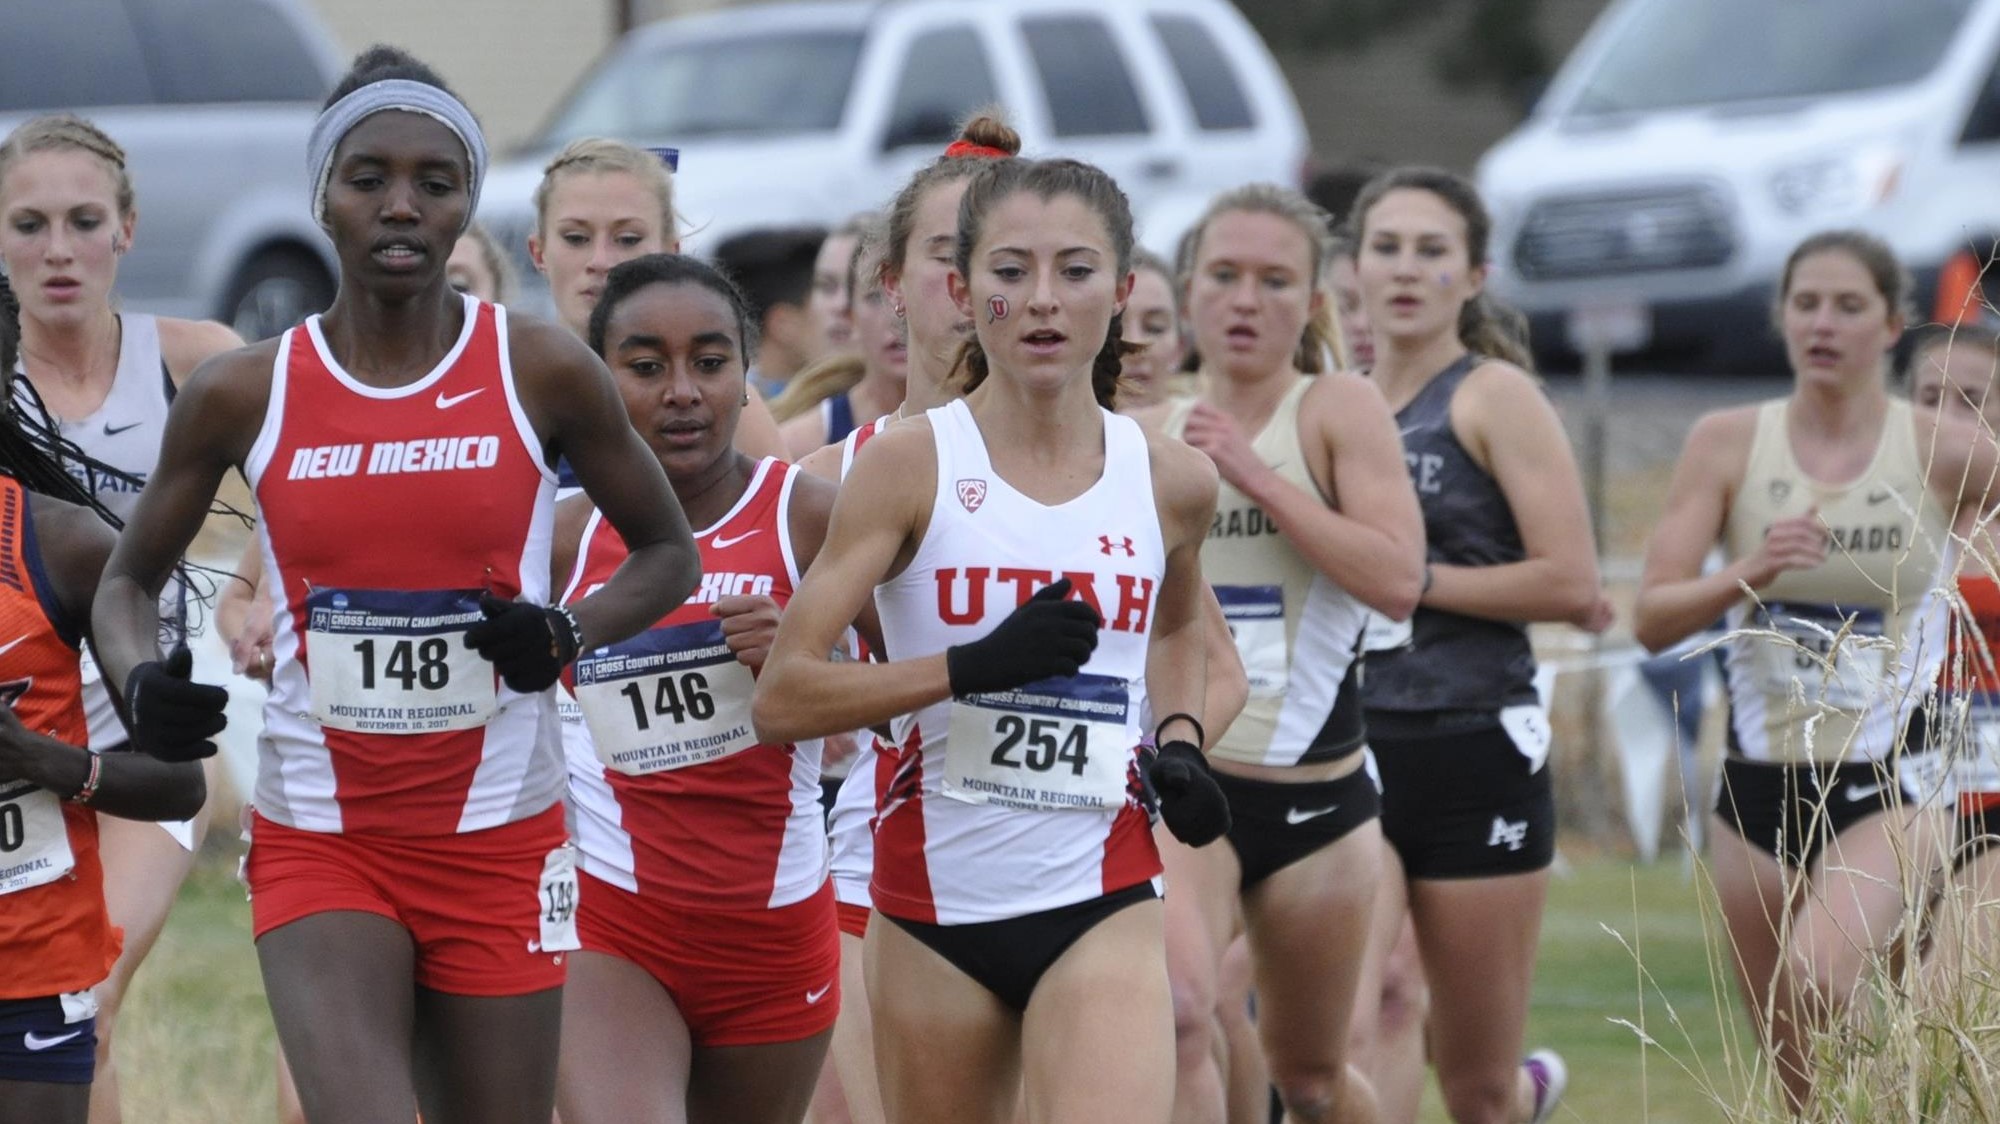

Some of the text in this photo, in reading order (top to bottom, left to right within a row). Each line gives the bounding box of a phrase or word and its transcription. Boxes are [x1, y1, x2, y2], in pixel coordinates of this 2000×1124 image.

[287, 435, 499, 480] NEW MEXICO
[959, 480, 986, 499] PAC
[964, 494, 980, 508] 12
[684, 572, 774, 605] XICO
[935, 567, 1153, 634] UTAH
[331, 610, 487, 628] CROSS COUNTRY CHAMPIONSHIP
[353, 638, 450, 690] 148
[595, 660, 624, 674] CROSS
[626, 654, 665, 670] COUNTRY
[666, 644, 731, 663] CHAMPIONSHI
[330, 704, 476, 719] MOUNTAIN REGIONAL
[620, 672, 715, 731] 146
[1015, 693, 1060, 708] COUNTRY
[1059, 697, 1126, 716] CHAMPIONSHIPS
[356, 721, 408, 730] NOVEMBER
[428, 720, 449, 729] 2017
[611, 725, 749, 764] MOUNTAIN REGIONAL
[639, 755, 689, 771] NOVEMBER
[707, 746, 726, 758] 2017
[991, 715, 1088, 776] 254
[962, 777, 1105, 808] MOUNTAIN REGIONAL
[0, 858, 52, 880] EGIONAL
